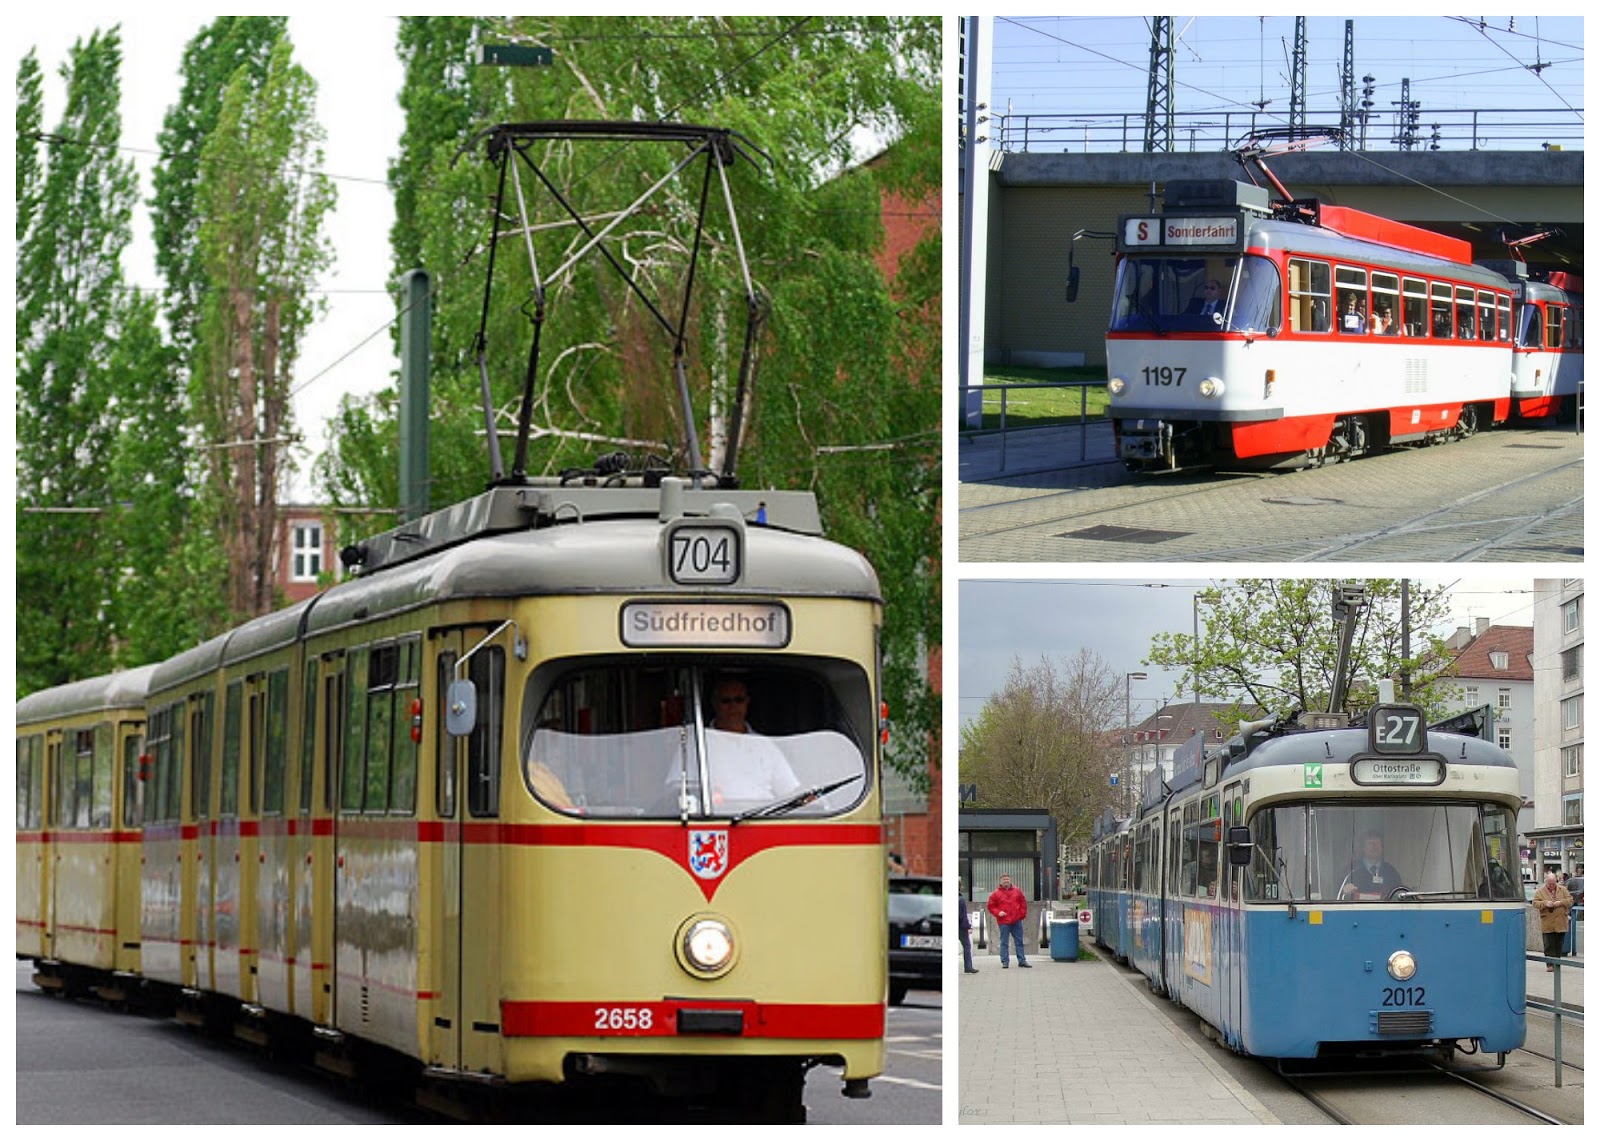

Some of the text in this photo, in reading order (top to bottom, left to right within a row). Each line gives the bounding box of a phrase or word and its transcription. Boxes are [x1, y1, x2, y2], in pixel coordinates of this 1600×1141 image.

[1137, 221, 1235, 241] S Sonderfahrt
[1141, 366, 1187, 387] 1197
[673, 536, 730, 573] 704
[633, 610, 776, 633] Südfriedhof
[1375, 716, 1419, 744] E27
[1372, 763, 1421, 773] Ottostraße
[1382, 987, 1425, 1006] 2012
[594, 1007, 653, 1030] 2658
